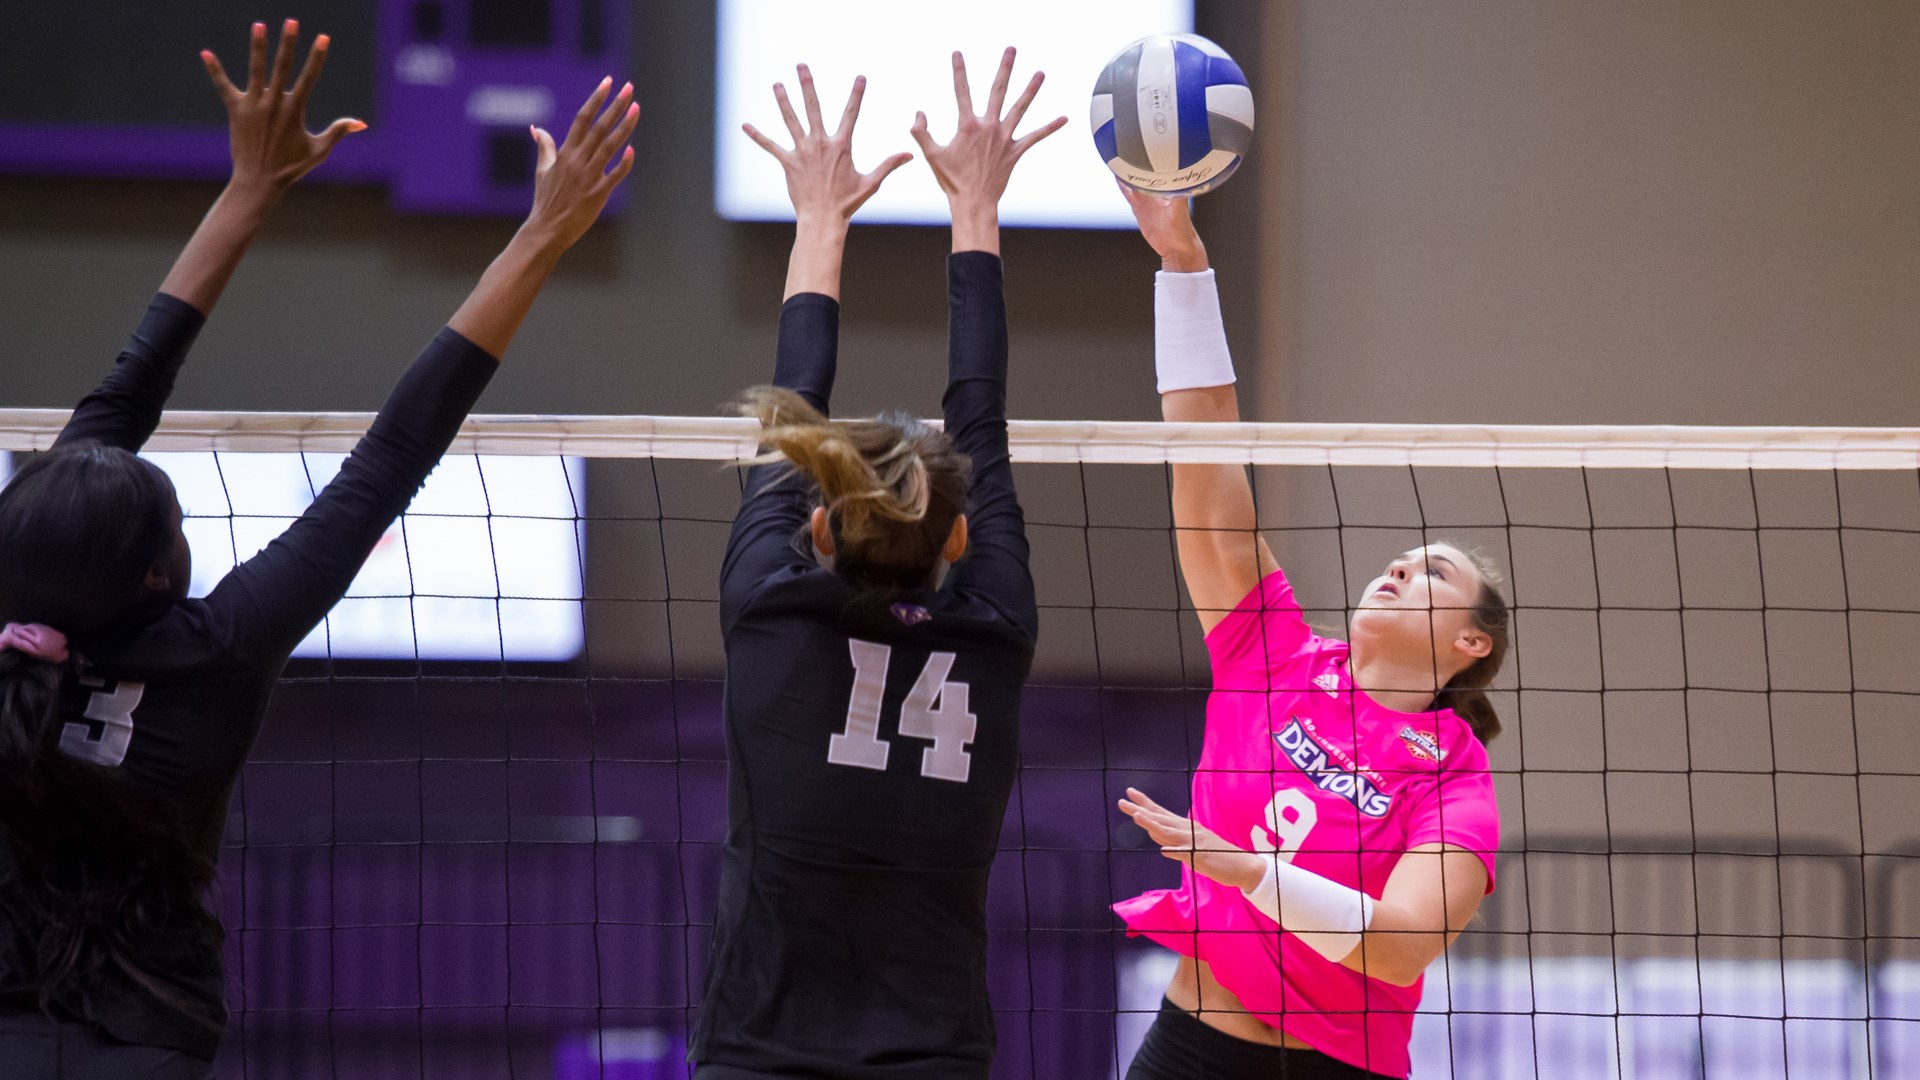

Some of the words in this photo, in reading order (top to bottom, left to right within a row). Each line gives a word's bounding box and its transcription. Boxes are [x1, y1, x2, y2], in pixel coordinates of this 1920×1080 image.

[1127, 174, 1167, 187] Touch
[58, 676, 145, 767] 3
[827, 638, 977, 783] 14
[1276, 721, 1392, 816] DEMONS
[1250, 788, 1318, 864] 9
